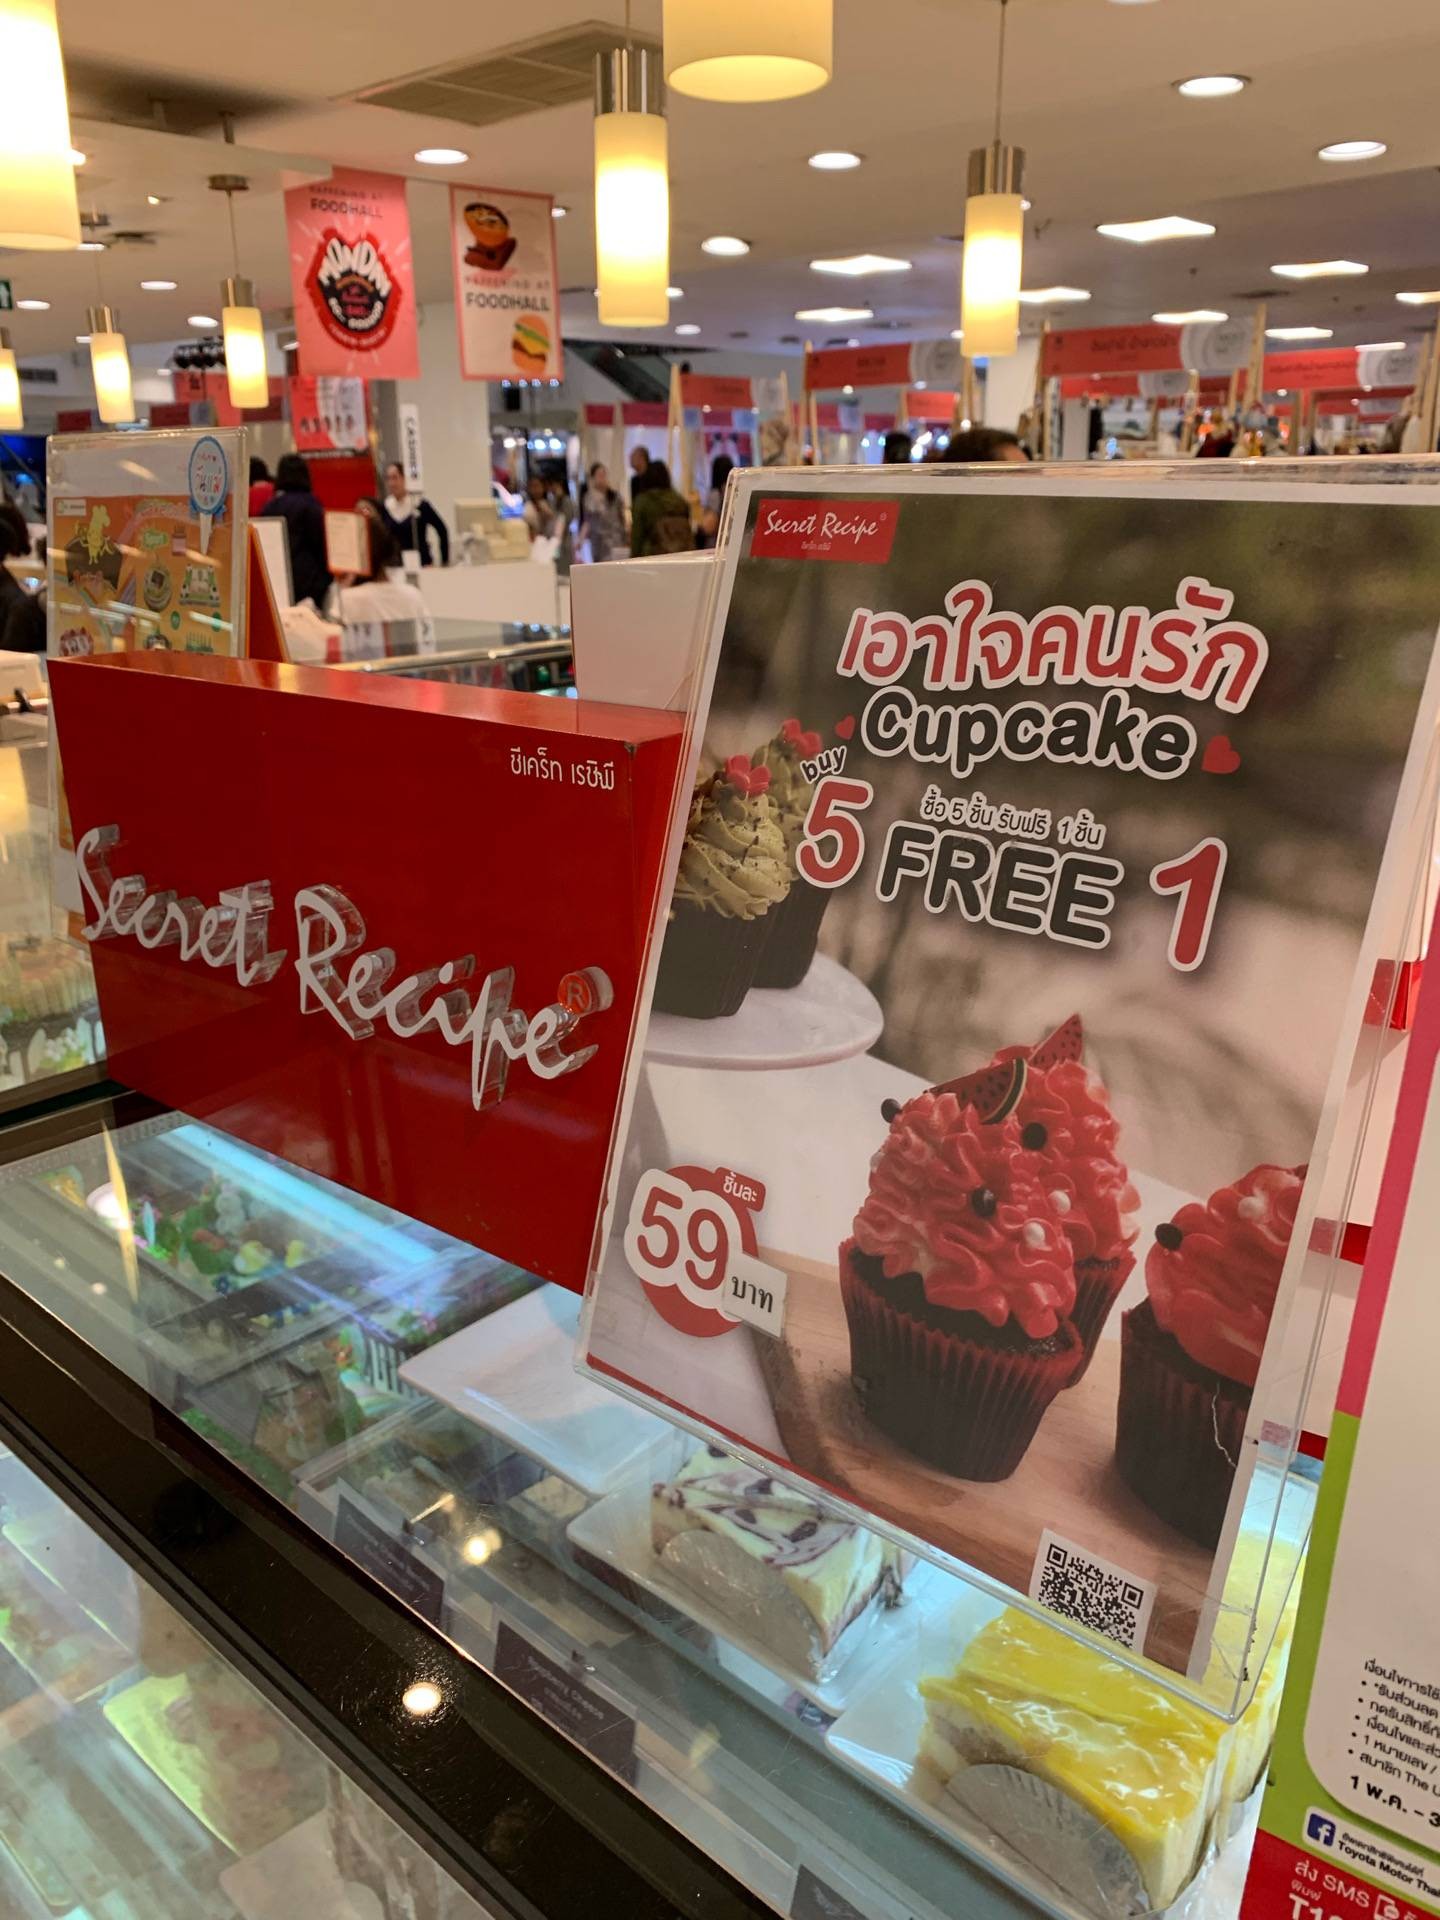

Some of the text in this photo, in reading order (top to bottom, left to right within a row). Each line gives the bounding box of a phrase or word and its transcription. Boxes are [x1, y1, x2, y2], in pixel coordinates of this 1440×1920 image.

[465, 292, 551, 312] FOODHALL
[763, 509, 879, 545] Secret Recipe
[839, 580, 1266, 711] เอาใจคนรัก
[863, 689, 1194, 777] Cupcake
[801, 745, 846, 782] buy
[798, 778, 871, 885] 5
[951, 802, 964, 821] 5
[998, 807, 1048, 836] รับฟรี
[877, 823, 1224, 968] FREE 1
[76, 824, 284, 988] Secret
[295, 884, 595, 1112] Recipe
[722, 1171, 758, 1203] ชิ้นละ
[636, 1185, 730, 1291] 59
[731, 1275, 774, 1313] บาท
[1405, 1770, 1430, 1791] The
[1294, 1859, 1370, 1908] ส่ง SMS
[1338, 1840, 1377, 1868] Toyota
[1379, 1860, 1415, 1885] Motor
